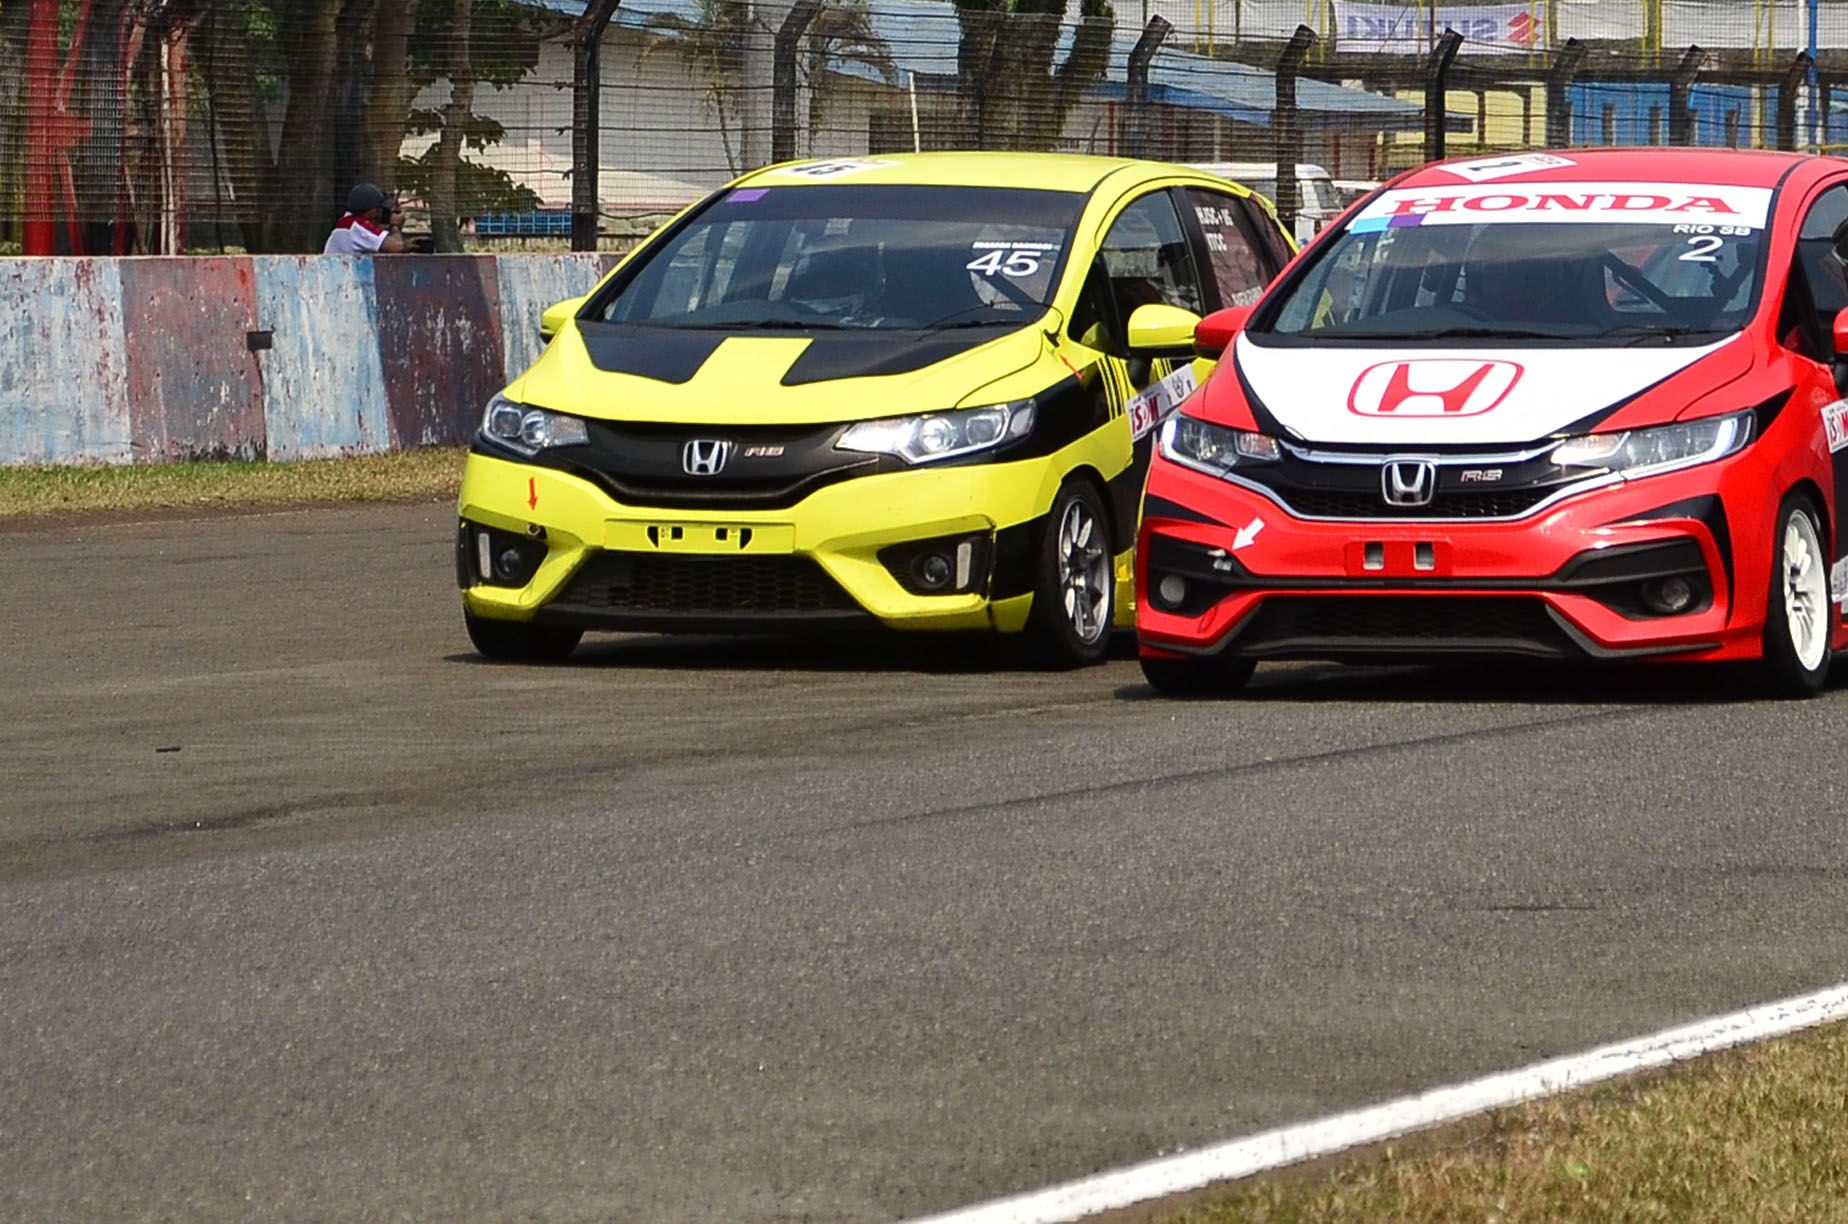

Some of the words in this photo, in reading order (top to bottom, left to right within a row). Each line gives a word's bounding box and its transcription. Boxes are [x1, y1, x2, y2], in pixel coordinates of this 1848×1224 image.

[1384, 193, 1742, 216] HONDA
[1673, 224, 1715, 234] RIO
[1678, 235, 1723, 262] 2
[966, 250, 1041, 276] 45
